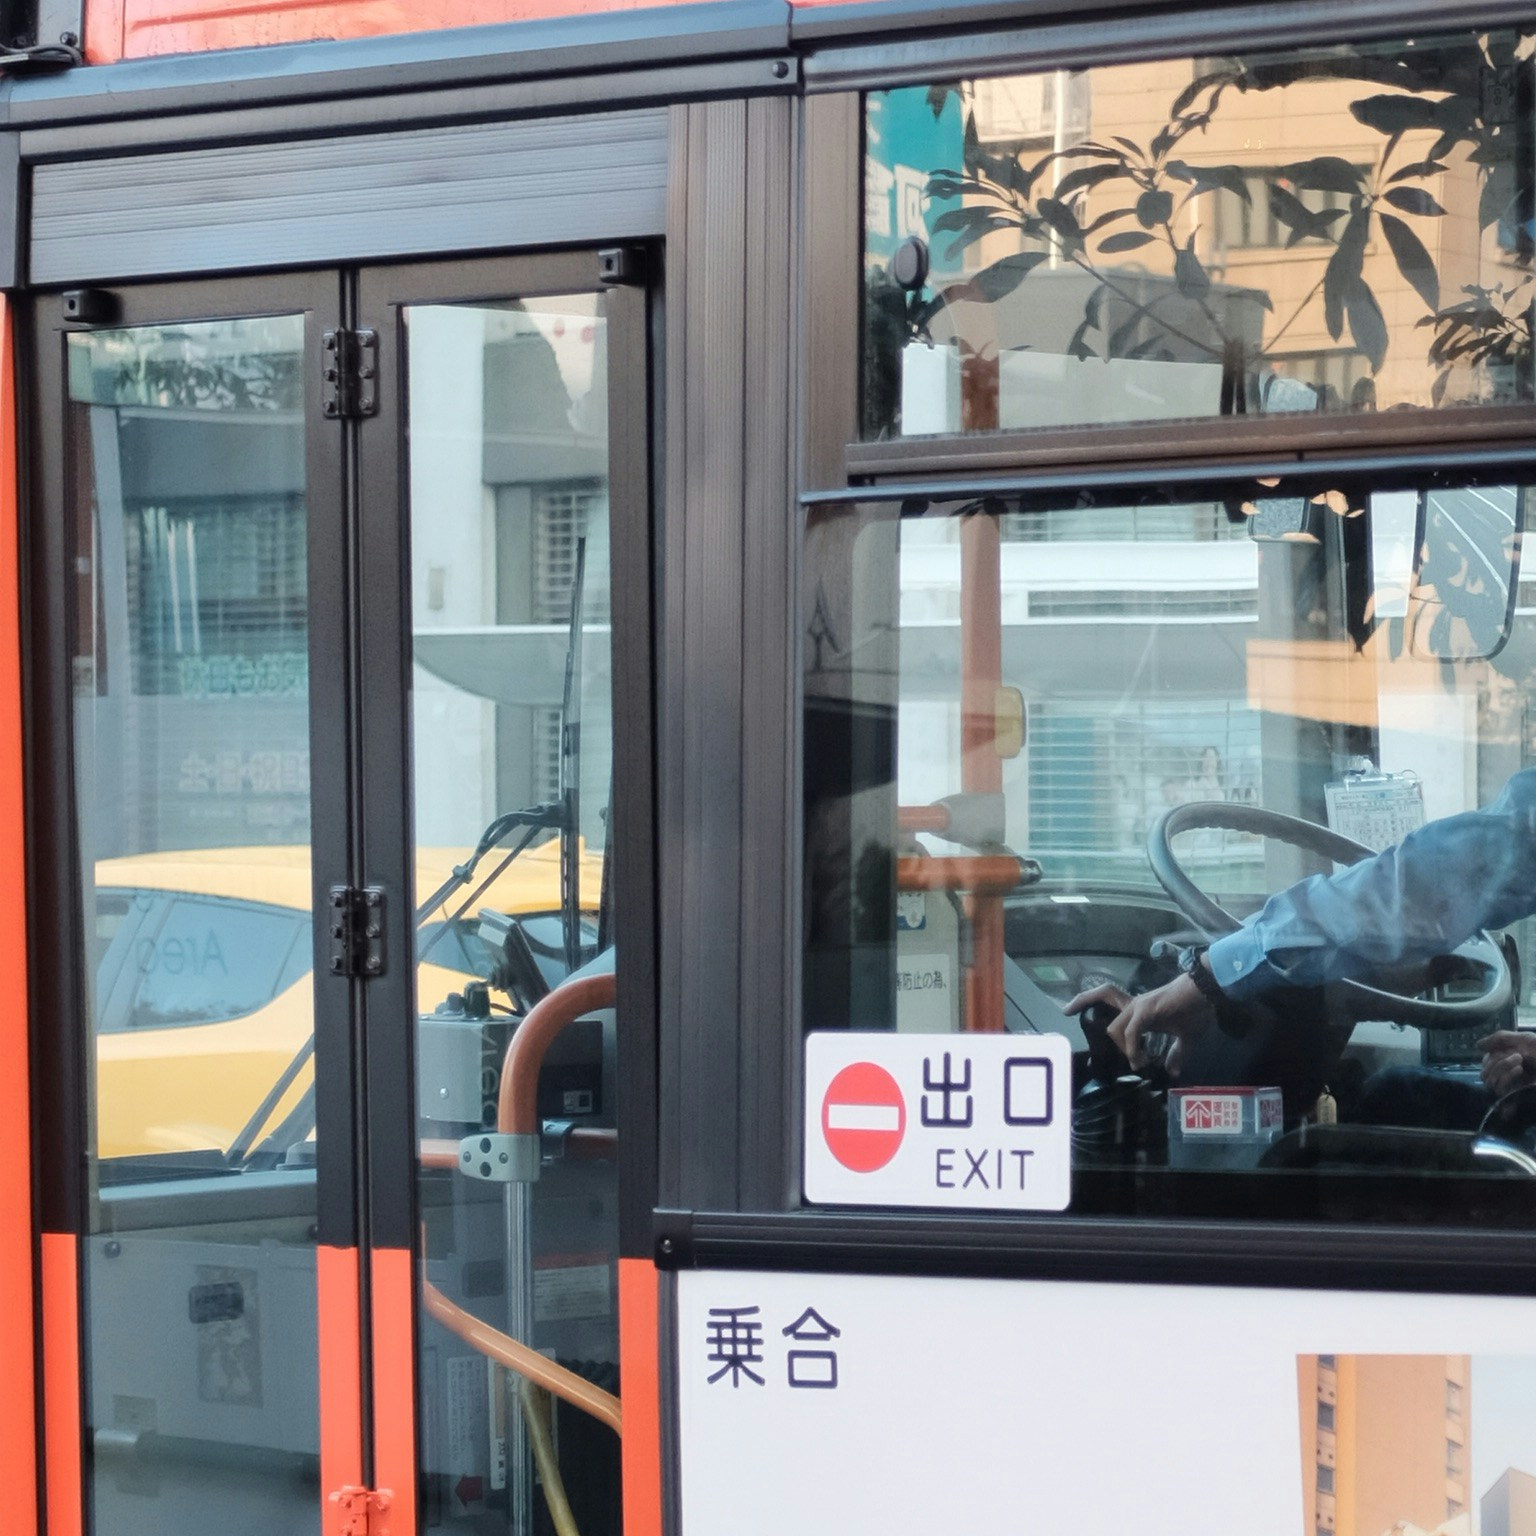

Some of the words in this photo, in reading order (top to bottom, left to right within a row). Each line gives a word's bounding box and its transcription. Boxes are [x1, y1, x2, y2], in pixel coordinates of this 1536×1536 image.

[920, 1051, 1054, 1128] 出口
[935, 1148, 1035, 1191] EXIT
[705, 1304, 842, 1390] 乗合
